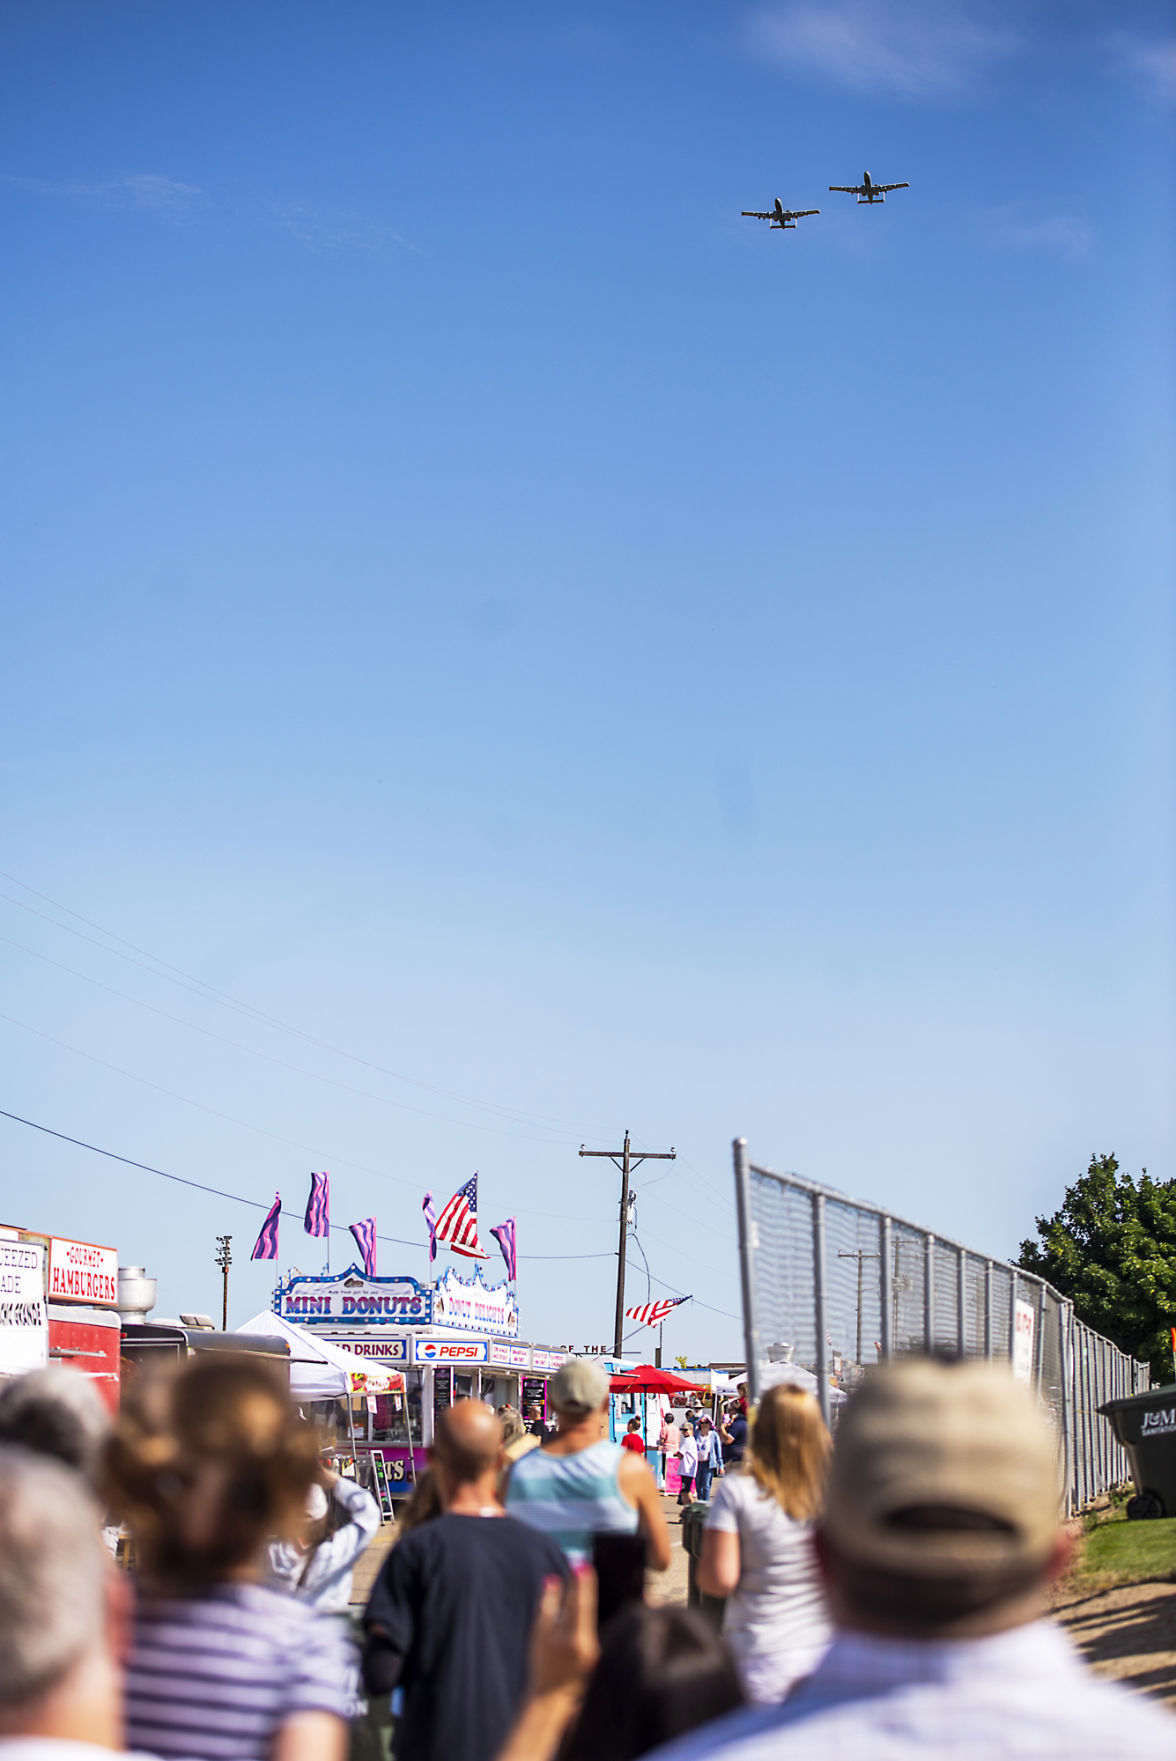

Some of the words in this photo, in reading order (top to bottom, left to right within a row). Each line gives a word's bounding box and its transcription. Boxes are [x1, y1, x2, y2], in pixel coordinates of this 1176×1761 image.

[70, 1246, 100, 1268] GOURMET
[52, 1267, 115, 1301] HAMBURGERS
[285, 1296, 332, 1314] MINI
[342, 1296, 422, 1315] DONUTS
[354, 1343, 399, 1356] DRINKS
[439, 1346, 478, 1357] PEPSI
[584, 1345, 607, 1353] THE
[1141, 1409, 1175, 1429] J&M
